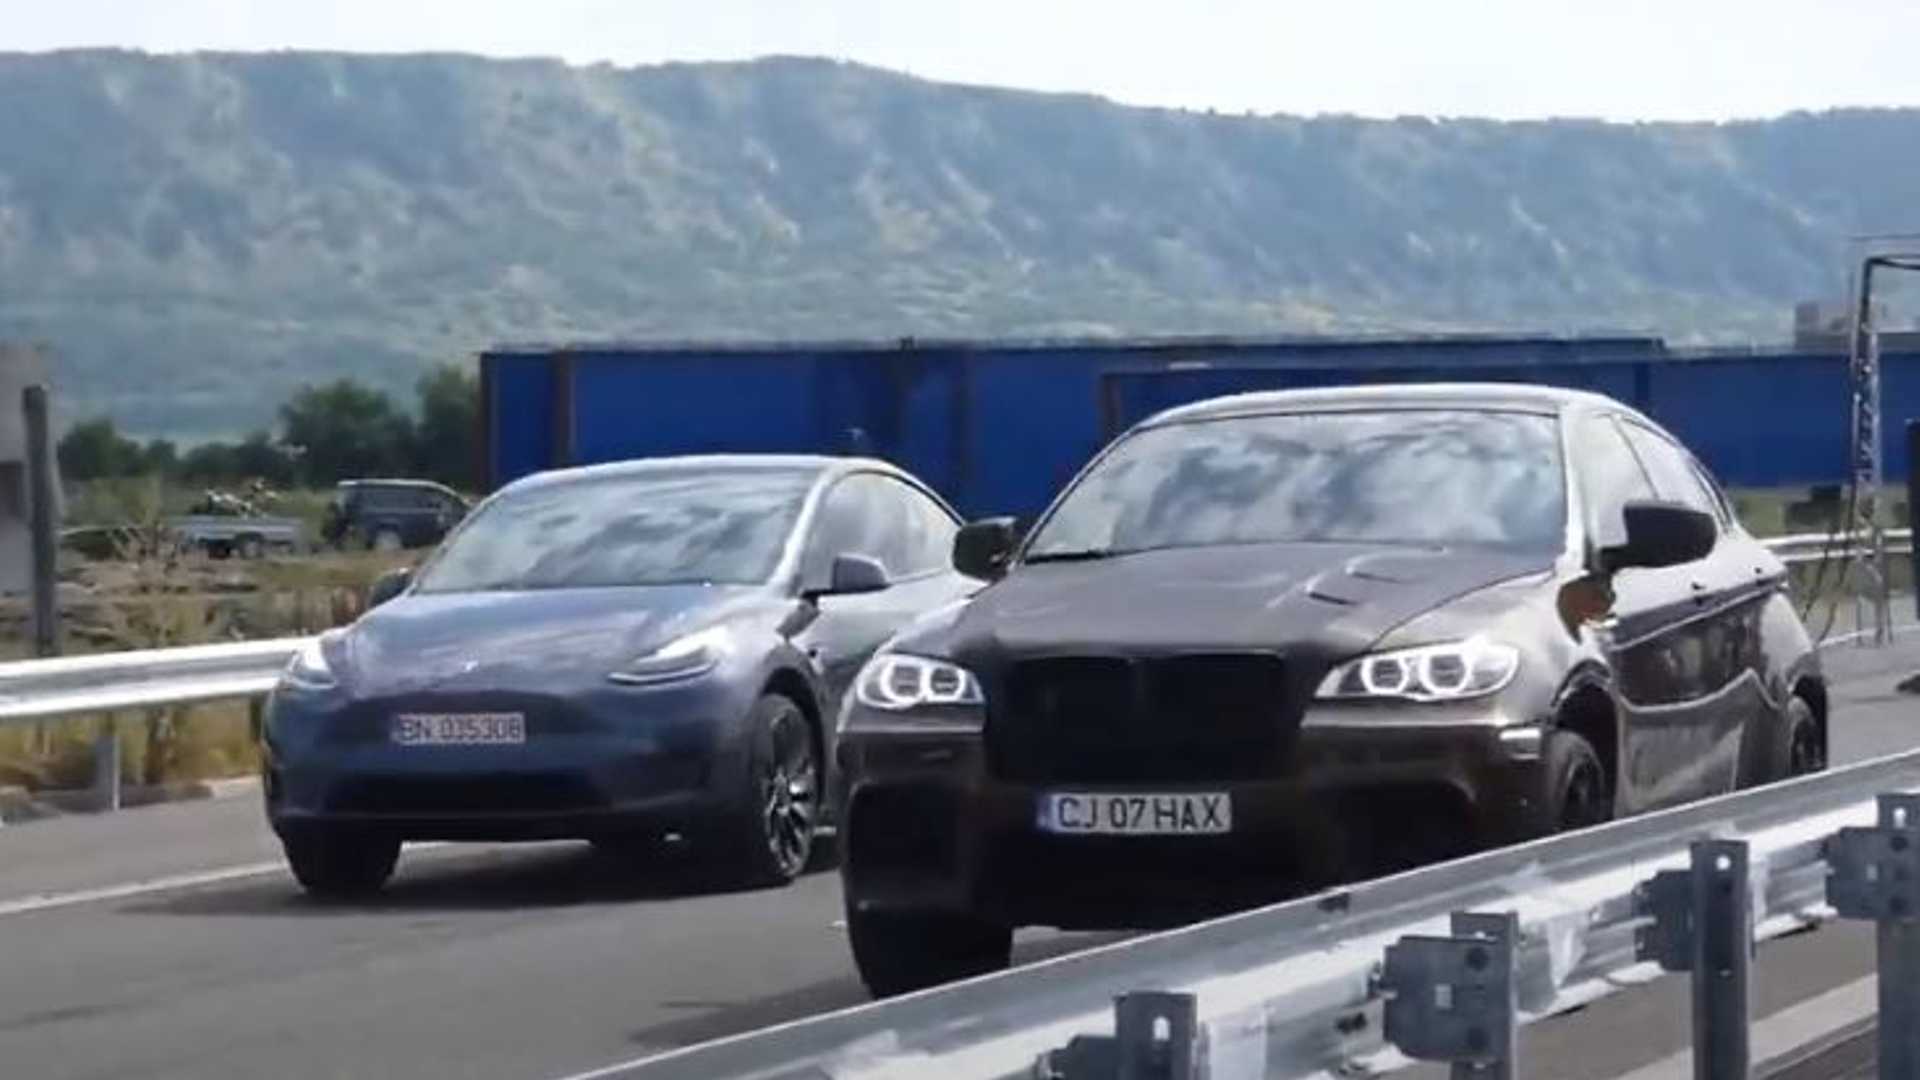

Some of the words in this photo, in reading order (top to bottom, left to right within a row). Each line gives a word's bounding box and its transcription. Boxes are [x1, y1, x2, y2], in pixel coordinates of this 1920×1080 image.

[1059, 797, 1098, 828] CJ
[1109, 797, 1146, 828] 07
[1153, 797, 1224, 829] HAX
